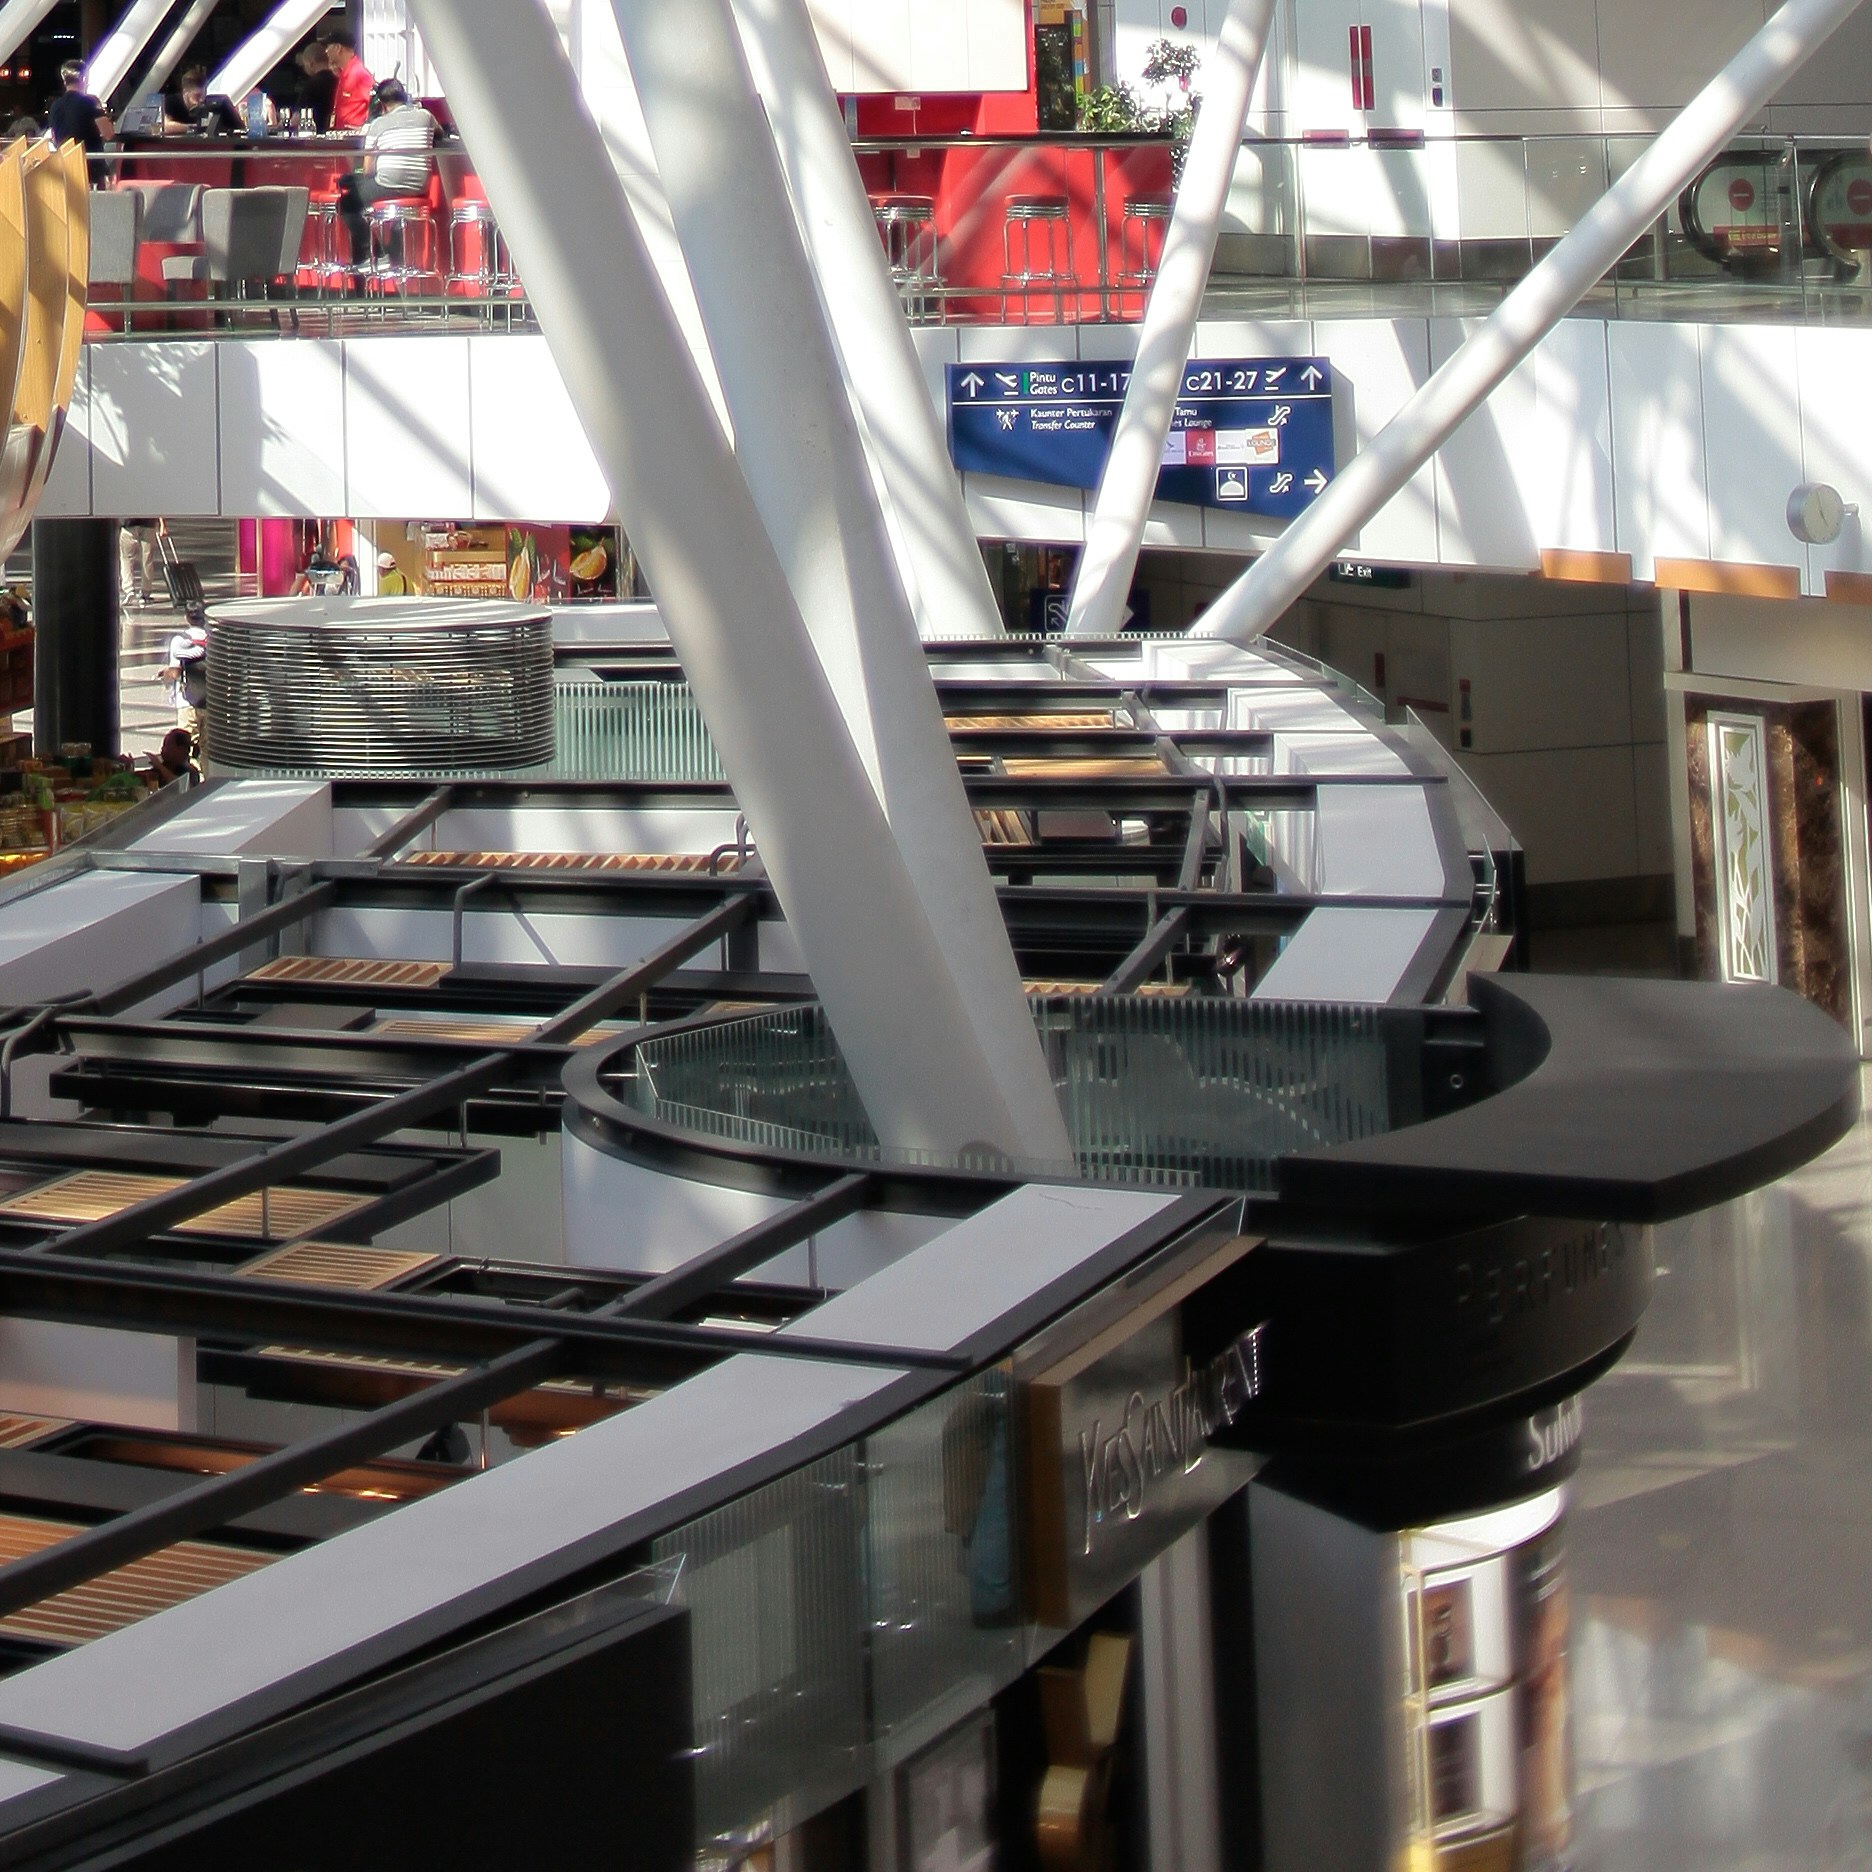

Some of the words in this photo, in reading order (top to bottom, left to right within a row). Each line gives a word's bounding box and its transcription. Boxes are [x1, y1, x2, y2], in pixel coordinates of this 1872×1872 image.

[1030, 371, 1056, 383] Pintu
[1030, 383, 1058, 395] Gates
[1030, 408, 1064, 418] Kaunter
[1066, 407, 1113, 418] Pertukaran
[1175, 407, 1197, 416] Tamu
[1032, 420, 1062, 431] Transfer
[1064, 419, 1095, 430] Counter
[1184, 418, 1212, 429] Lounge
[1356, 564, 1373, 578] Exit
